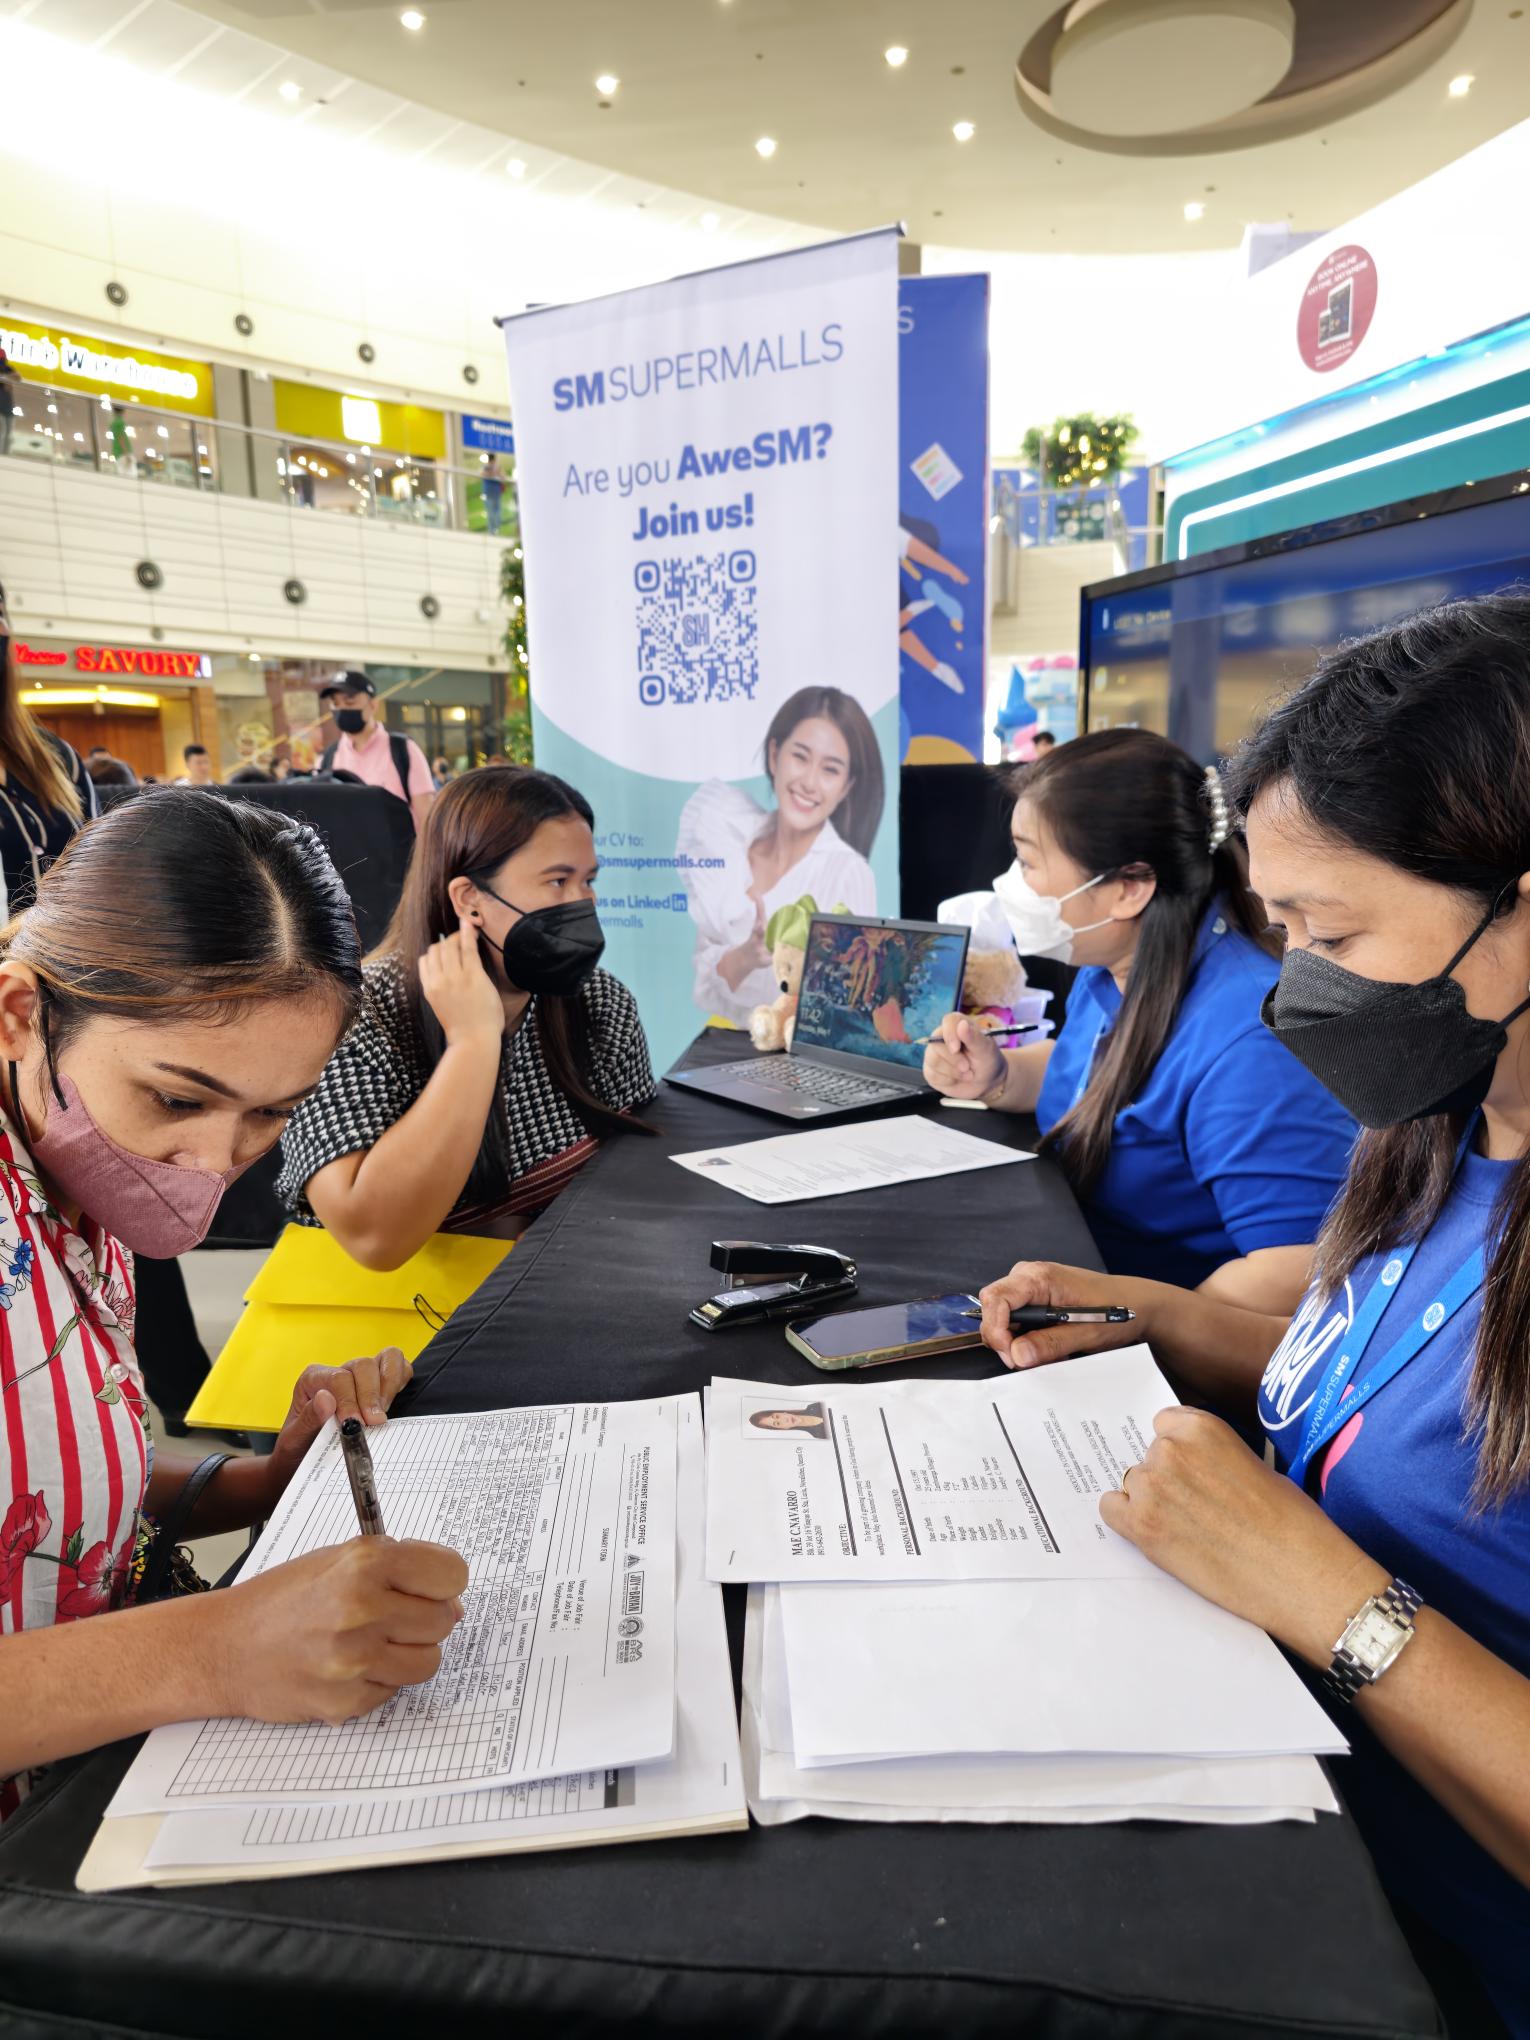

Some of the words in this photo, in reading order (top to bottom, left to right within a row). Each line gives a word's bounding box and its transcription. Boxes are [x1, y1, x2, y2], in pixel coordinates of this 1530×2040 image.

[553, 371, 605, 411] SM
[608, 324, 844, 402] SUPERMALLS
[563, 463, 609, 498] Are
[617, 459, 671, 498] you
[676, 422, 833, 480] AweSM?
[632, 502, 699, 541] Join
[705, 492, 755, 531] us!
[75, 645, 200, 677] SAVORY
[609, 833, 626, 847] CV
[628, 833, 645, 847] to:
[611, 898, 625, 908] on
[643, 1446, 651, 1462] PUBLIC
[640, 1463, 649, 1499] EMPLOYMENT
[639, 1500, 648, 1523] SERVICE
[638, 1524, 646, 1545] OFFICE
[791, 1537, 804, 1556] MAE
[839, 1523, 851, 1556] OBJECTIVE:
[902, 1527, 915, 1556] PERSONAL
[1031, 1514, 1054, 1553] EDUCATIONAL
[567, 1580, 576, 1592] Date
[628, 1591, 640, 1612] BAYAN
